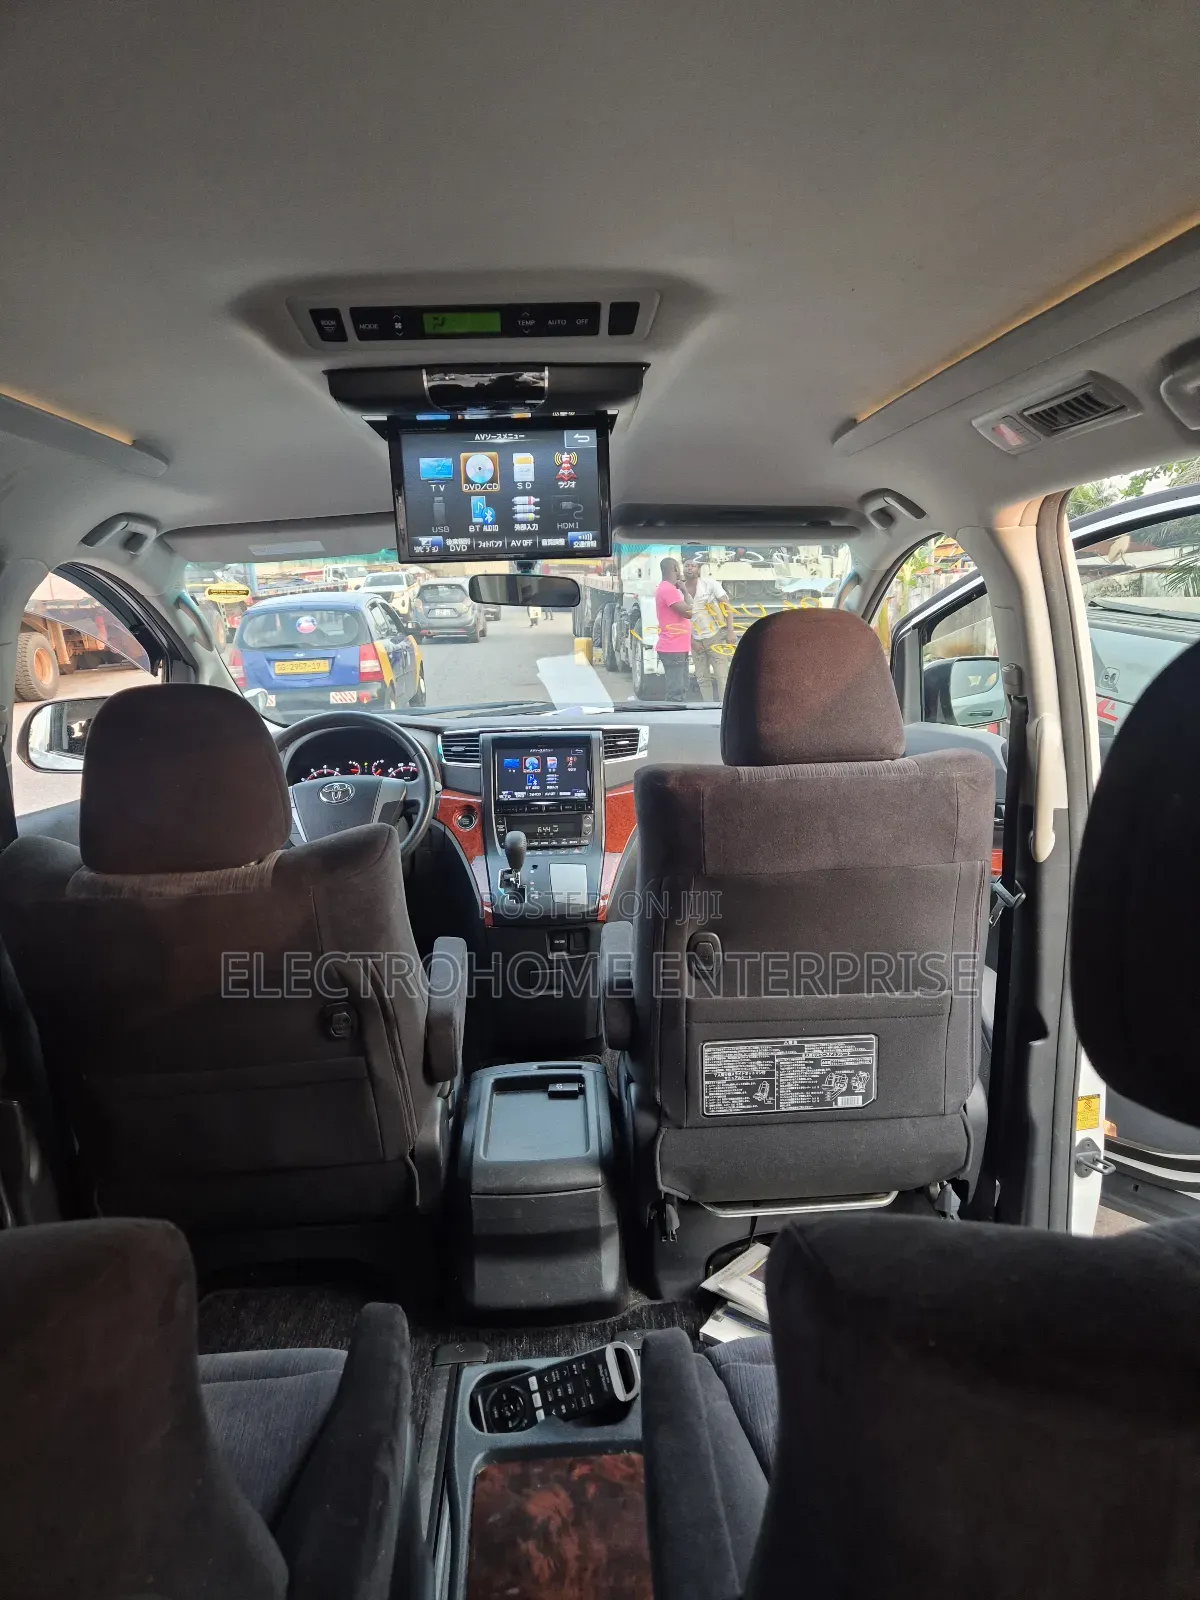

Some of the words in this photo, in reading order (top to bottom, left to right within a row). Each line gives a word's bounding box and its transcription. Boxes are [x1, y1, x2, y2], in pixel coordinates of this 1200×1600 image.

[474, 432, 525, 441] AVソースメニュー
[463, 483, 499, 491] DVD/CD
[557, 480, 577, 489] ラジオ
[431, 525, 450, 533] USB
[468, 524, 481, 532] BT
[482, 524, 499, 532] AUDIO
[514, 523, 539, 531] 外部入力
[556, 522, 579, 530] HDMI
[510, 539, 522, 547] AV
[522, 539, 533, 547] OFF
[573, 540, 597, 548] 交通情報
[449, 544, 468, 552] DVD
